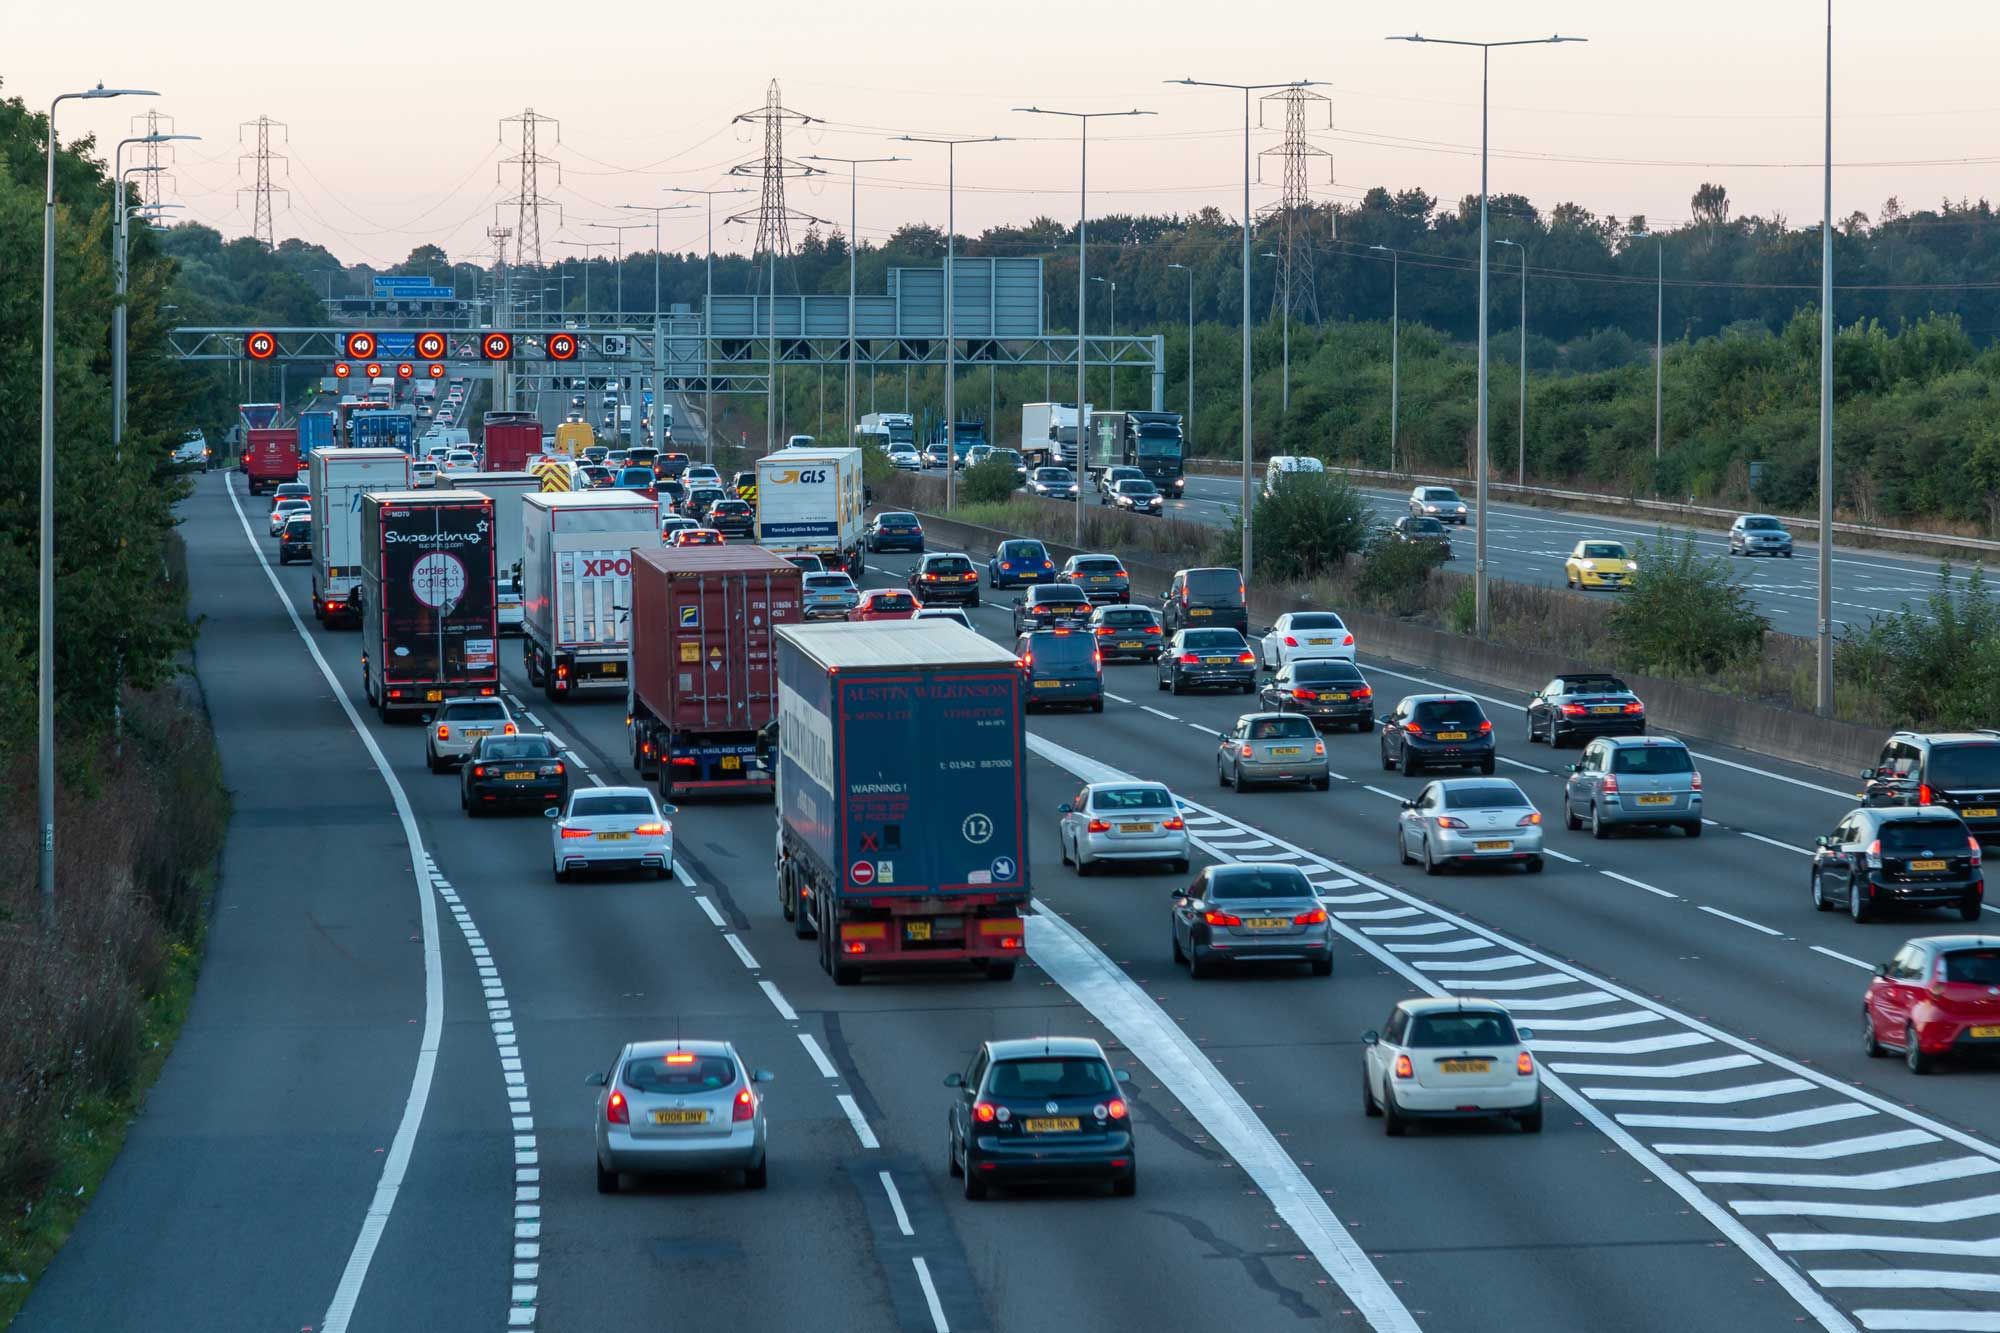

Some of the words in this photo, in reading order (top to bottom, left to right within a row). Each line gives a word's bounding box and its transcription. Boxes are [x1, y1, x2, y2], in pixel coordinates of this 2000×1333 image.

[254, 340, 268, 350] 40
[354, 340, 368, 350] 40
[424, 340, 438, 350] 40
[490, 340, 504, 350] 40
[555, 340, 569, 350] 40
[800, 470, 826, 484] GLS
[384, 531, 481, 544] Superdrug
[417, 565, 449, 576] order
[451, 565, 459, 575] &
[582, 558, 632, 577] XPO
[417, 575, 459, 588] collect
[849, 687, 909, 701] AUSTIN
[914, 684, 1008, 698] WILKINSON
[703, 746, 736, 754] HAULAGE
[851, 783, 902, 793] WARNING
[968, 821, 987, 836] 12
